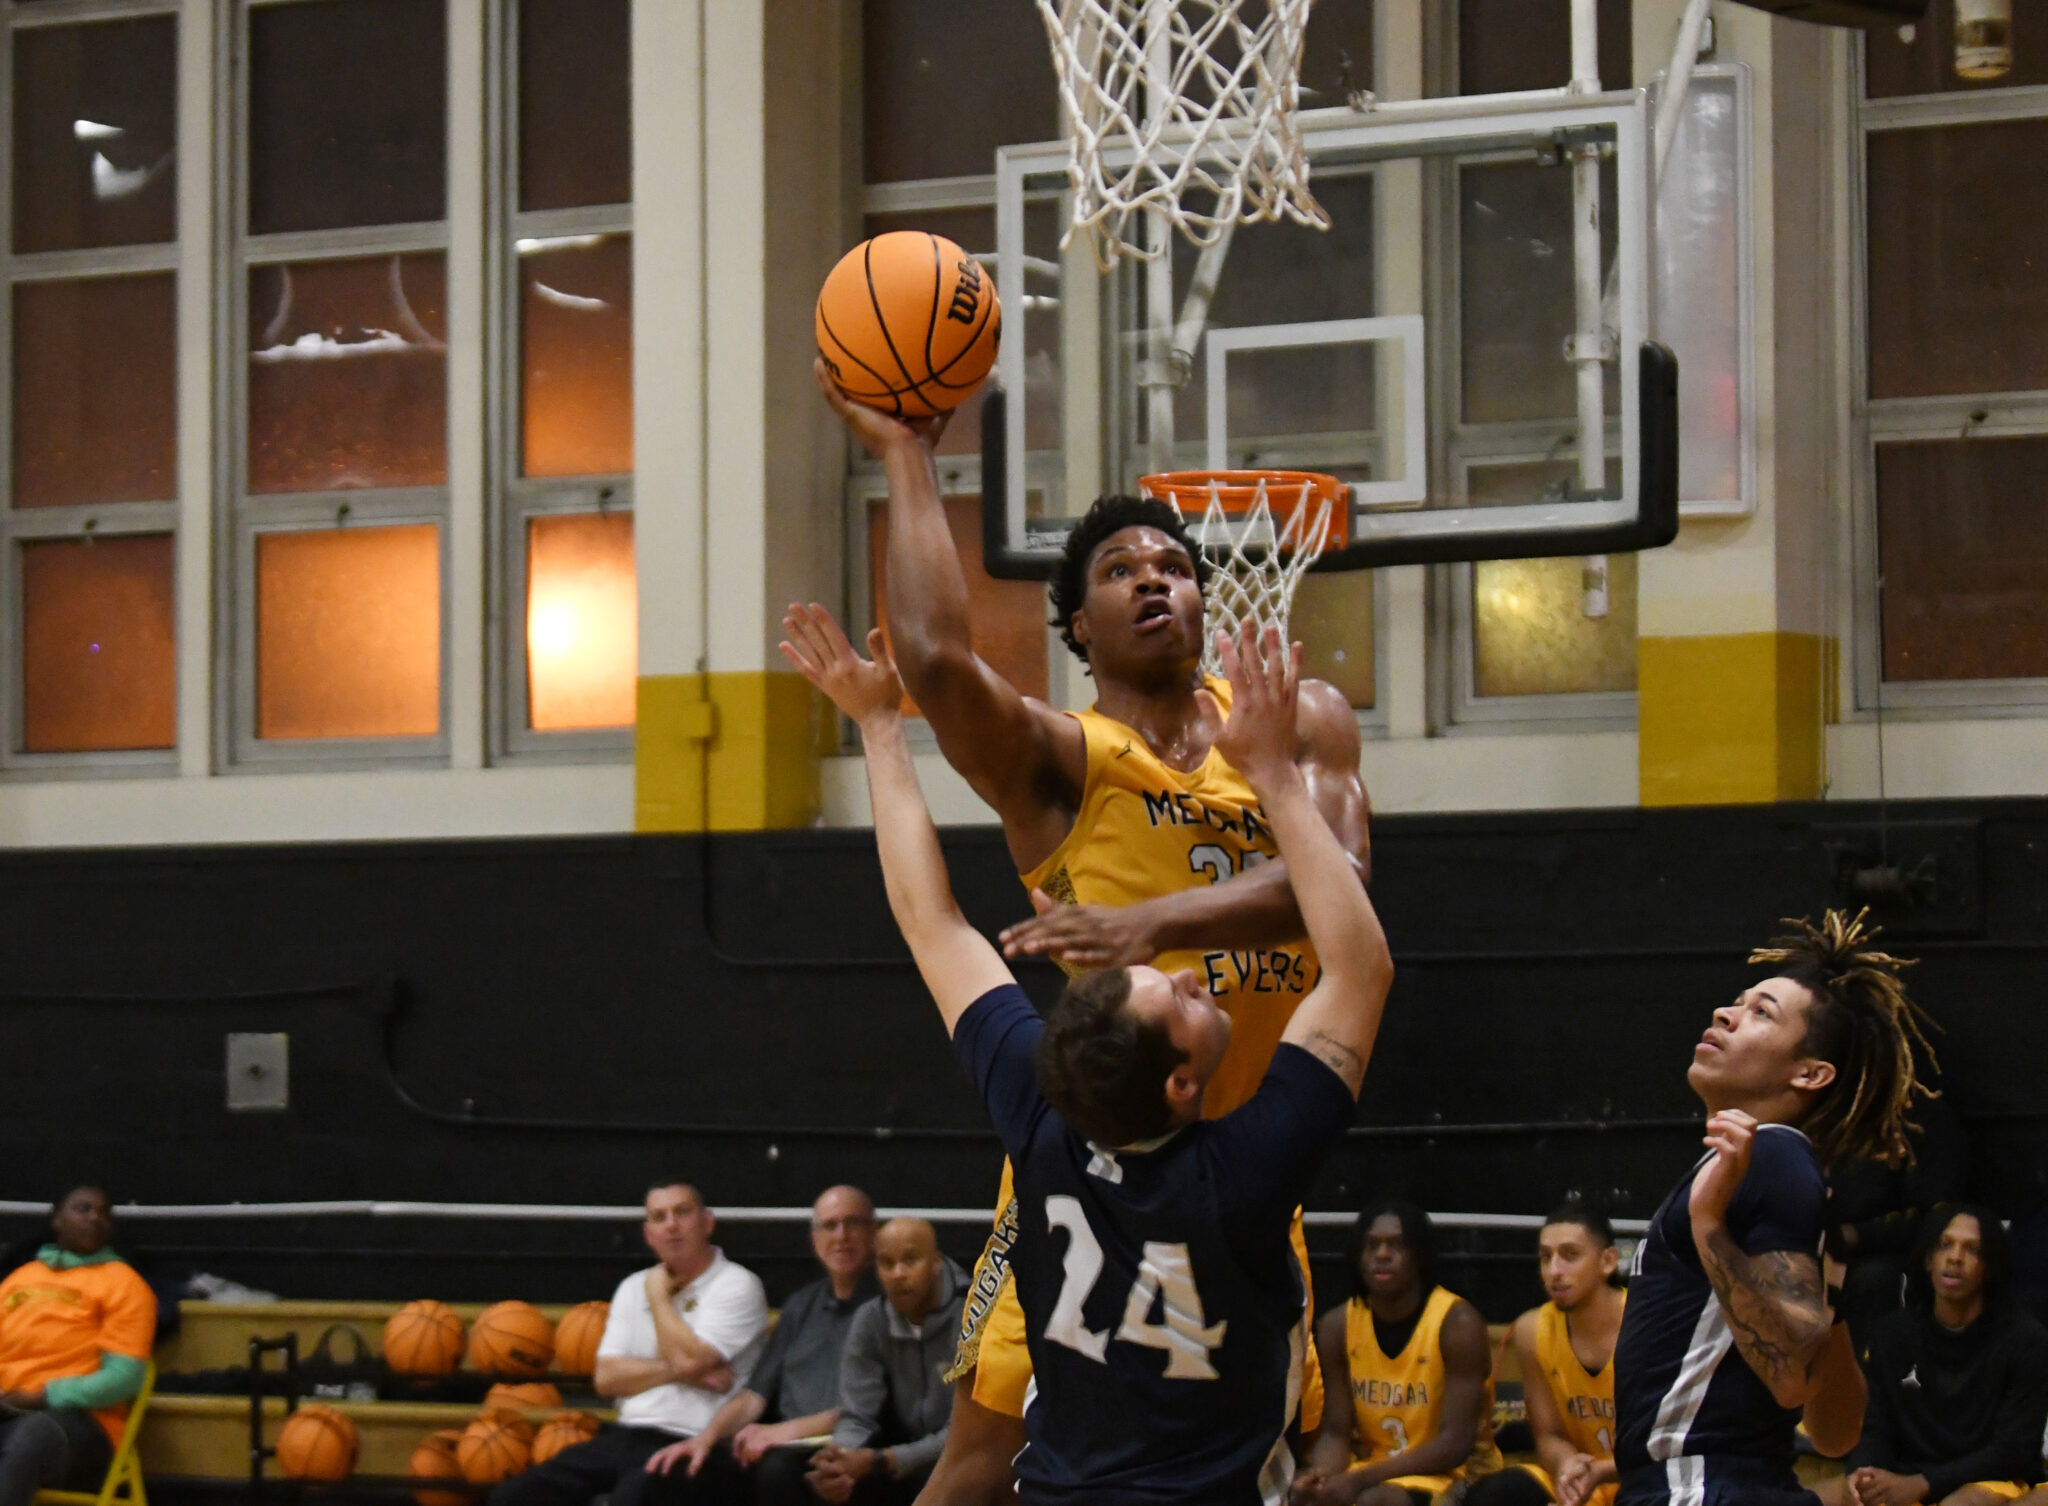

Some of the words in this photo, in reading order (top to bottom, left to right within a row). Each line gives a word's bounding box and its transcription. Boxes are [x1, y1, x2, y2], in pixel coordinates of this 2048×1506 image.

[1203, 948, 1305, 996] EVERS
[1045, 1194, 1228, 1380] 24
[1352, 1378, 1429, 1407] MEDGAR
[1567, 1395, 1616, 1419] MEDG
[1381, 1417, 1408, 1458] 3
